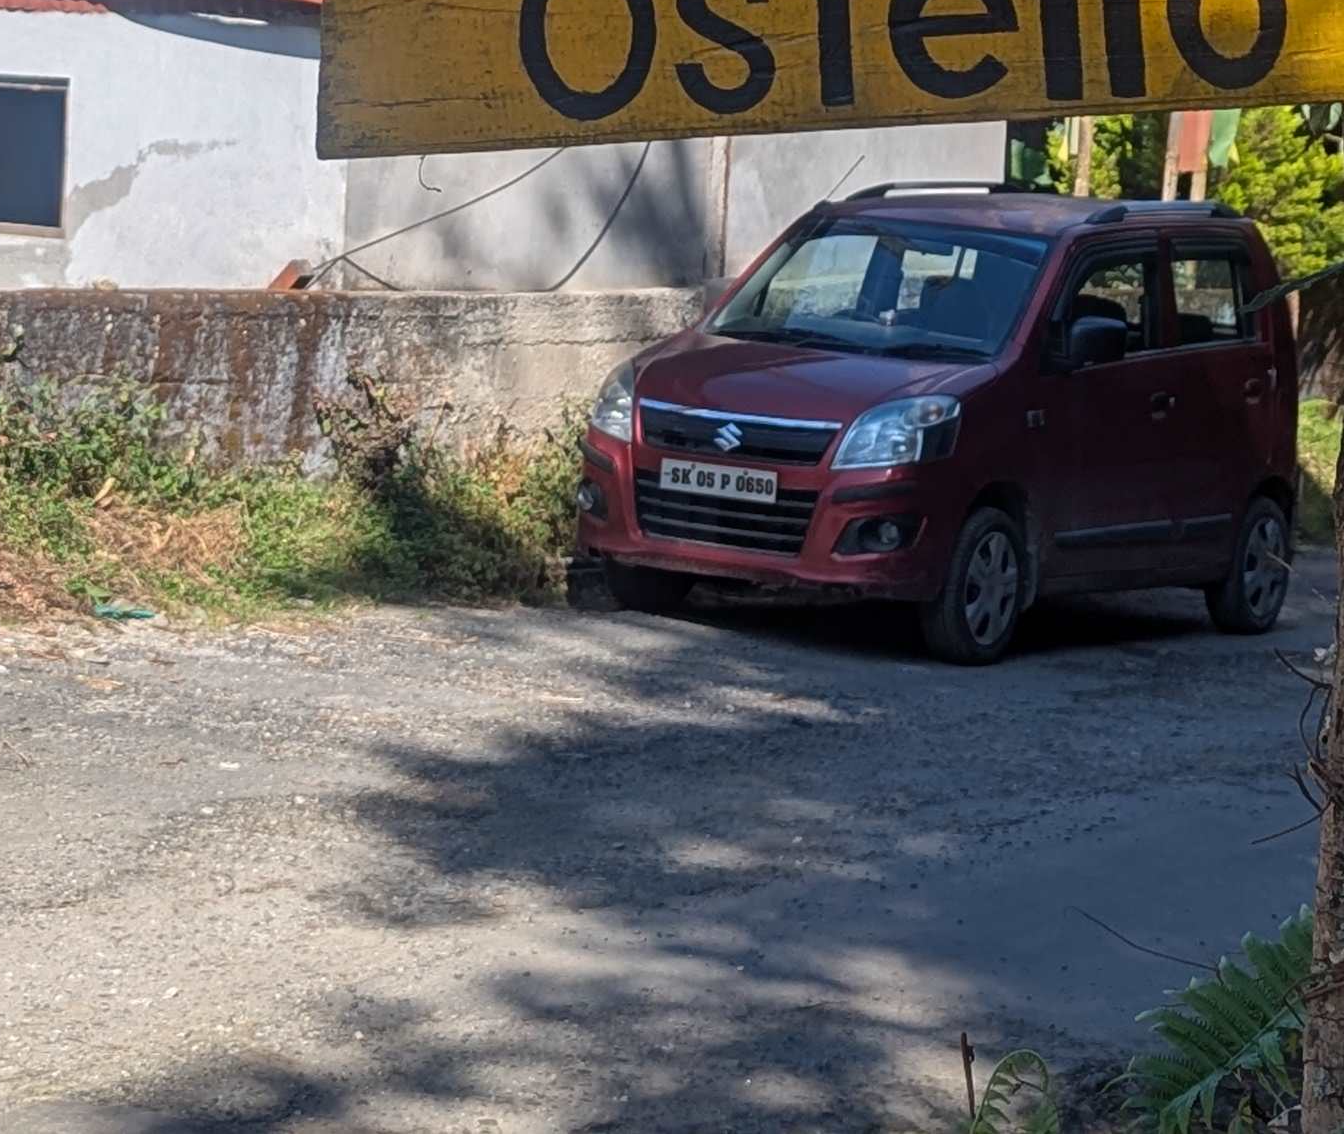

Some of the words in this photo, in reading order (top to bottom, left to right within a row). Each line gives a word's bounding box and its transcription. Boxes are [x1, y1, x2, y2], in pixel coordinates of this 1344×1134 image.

[671, 467, 692, 485] SK
[696, 470, 716, 488] 05
[720, 474, 731, 490] P
[736, 476, 774, 496] 0650
